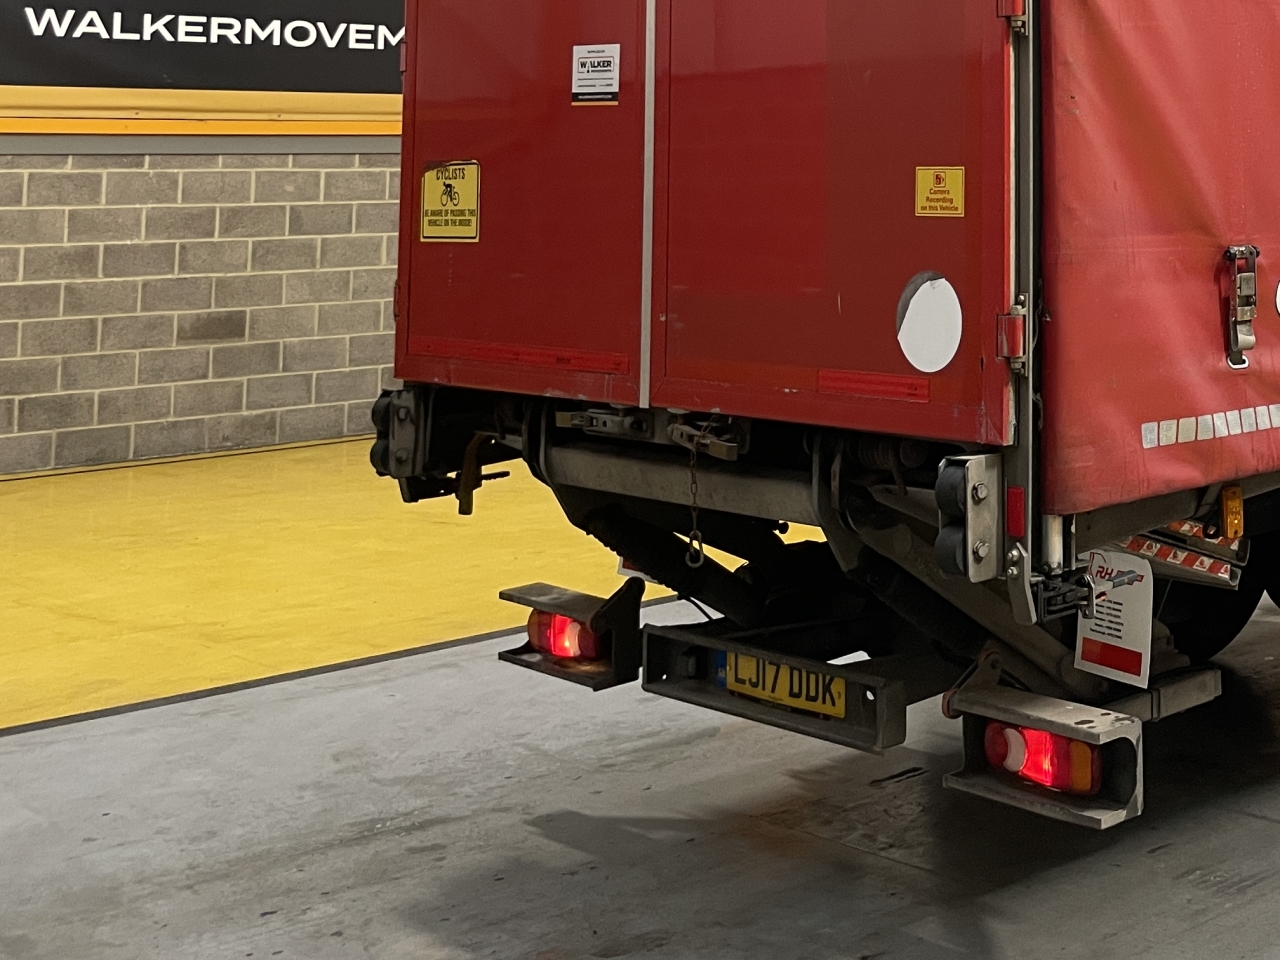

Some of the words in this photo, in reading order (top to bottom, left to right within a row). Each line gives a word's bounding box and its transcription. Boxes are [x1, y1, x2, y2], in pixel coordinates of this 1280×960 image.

[580, 60, 612, 74] WALKER
[436, 167, 466, 180] CYCLISTS
[1095, 565, 1115, 580] RH
[733, 651, 781, 695] LJ17
[788, 666, 837, 708] DDK
